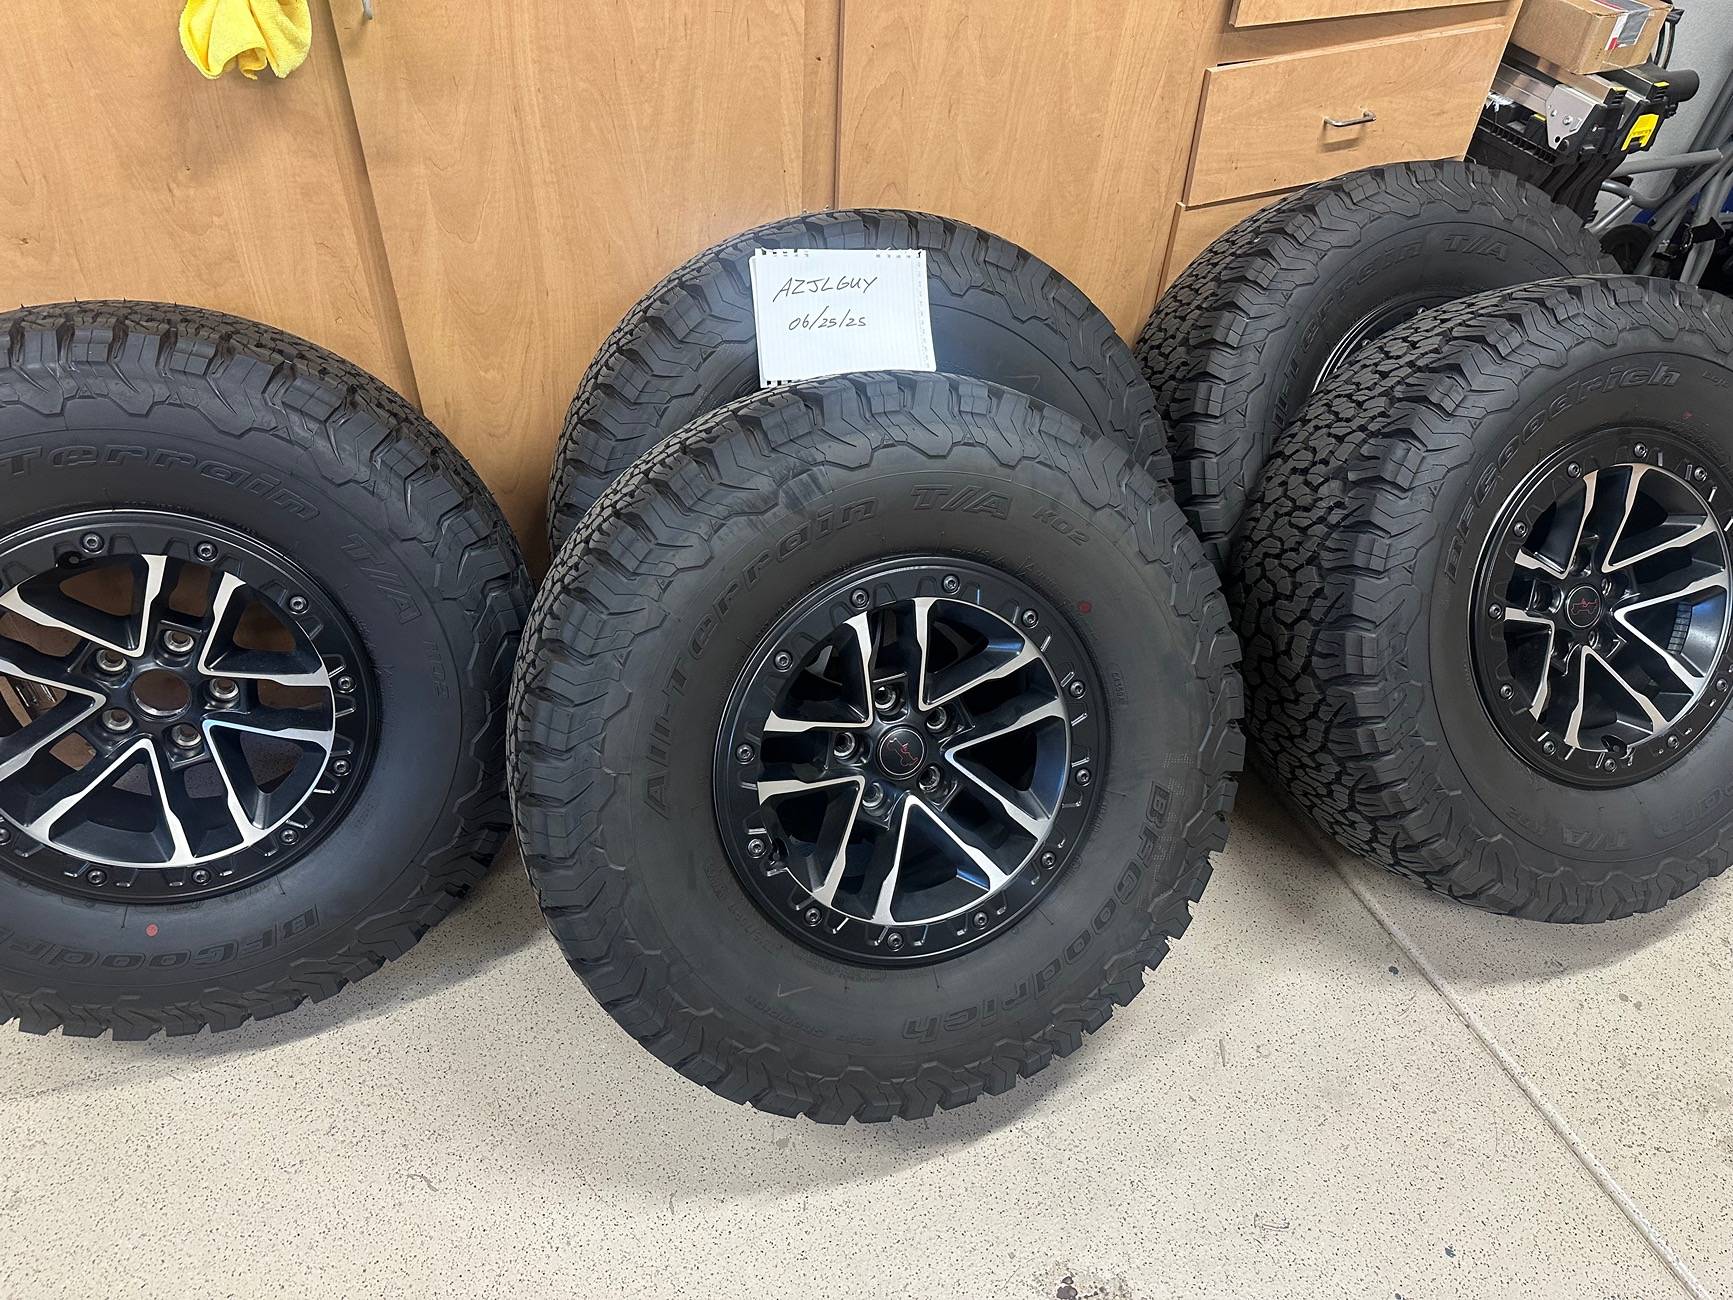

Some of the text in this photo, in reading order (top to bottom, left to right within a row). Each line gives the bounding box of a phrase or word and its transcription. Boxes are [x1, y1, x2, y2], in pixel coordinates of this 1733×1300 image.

[772, 276, 877, 302] AZJLGUY
[788, 305, 867, 331] 06/25/25
[643, 496, 879, 821] All-Terrain
[911, 484, 1014, 521] T/A
[902, 779, 1172, 1044] BFGoodrich
